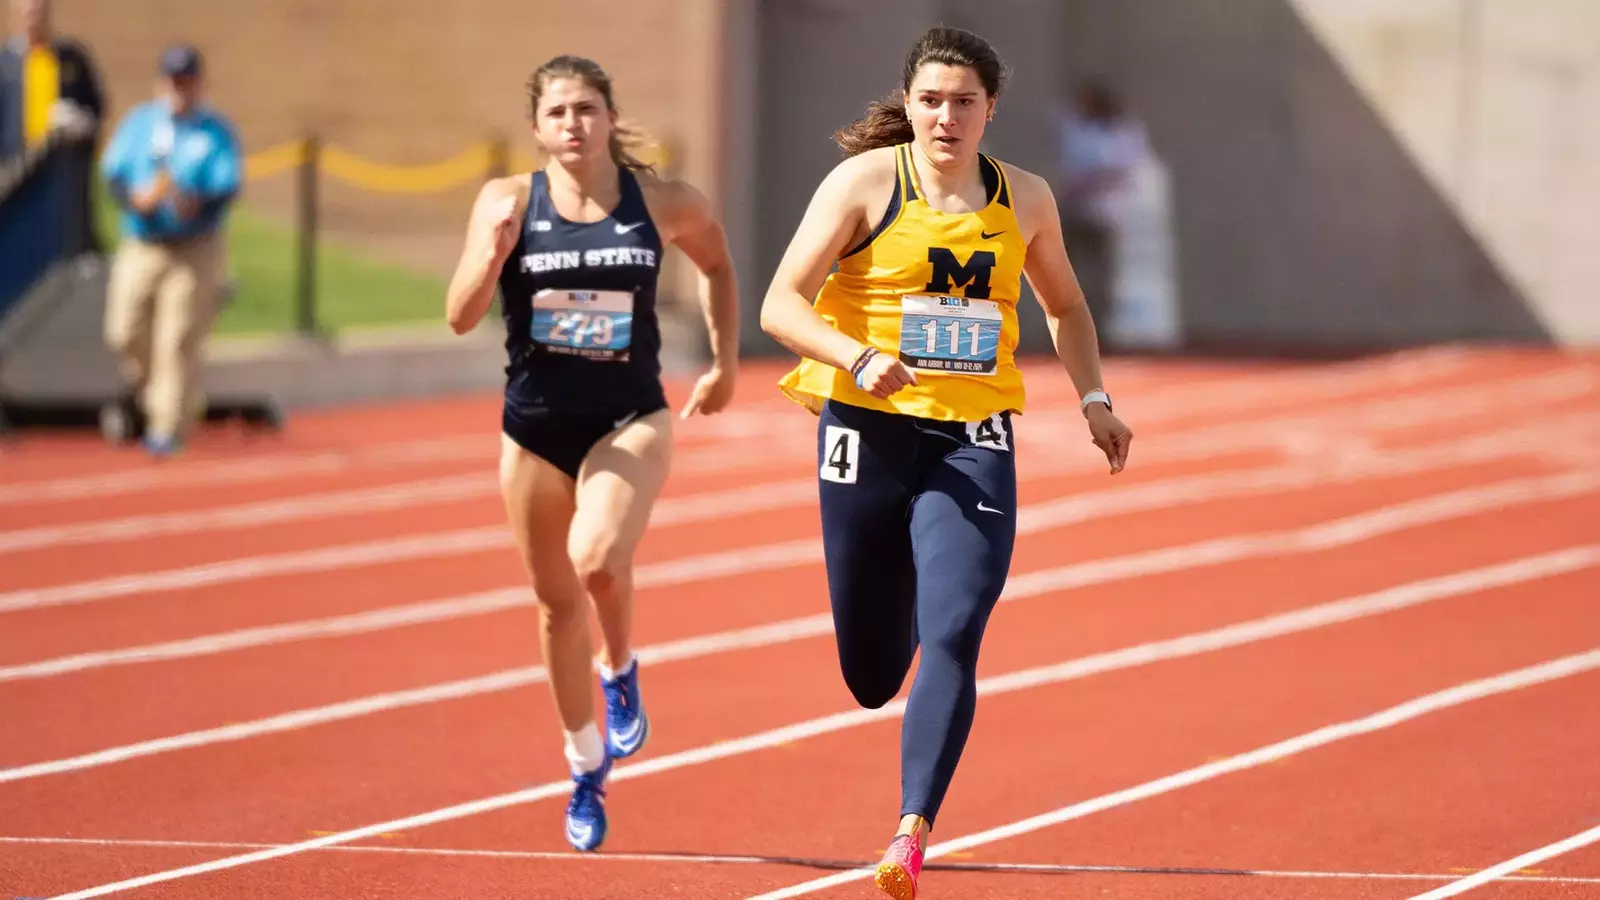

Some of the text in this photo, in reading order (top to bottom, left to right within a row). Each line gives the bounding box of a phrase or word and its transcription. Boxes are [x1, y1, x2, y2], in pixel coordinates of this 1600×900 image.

[520, 247, 656, 273] PENN STATE
[925, 247, 996, 299] M
[548, 311, 615, 345] 279
[921, 319, 981, 356] 111
[917, 359, 928, 368] ANN
[975, 416, 1002, 446] 4
[828, 433, 851, 479] 4
